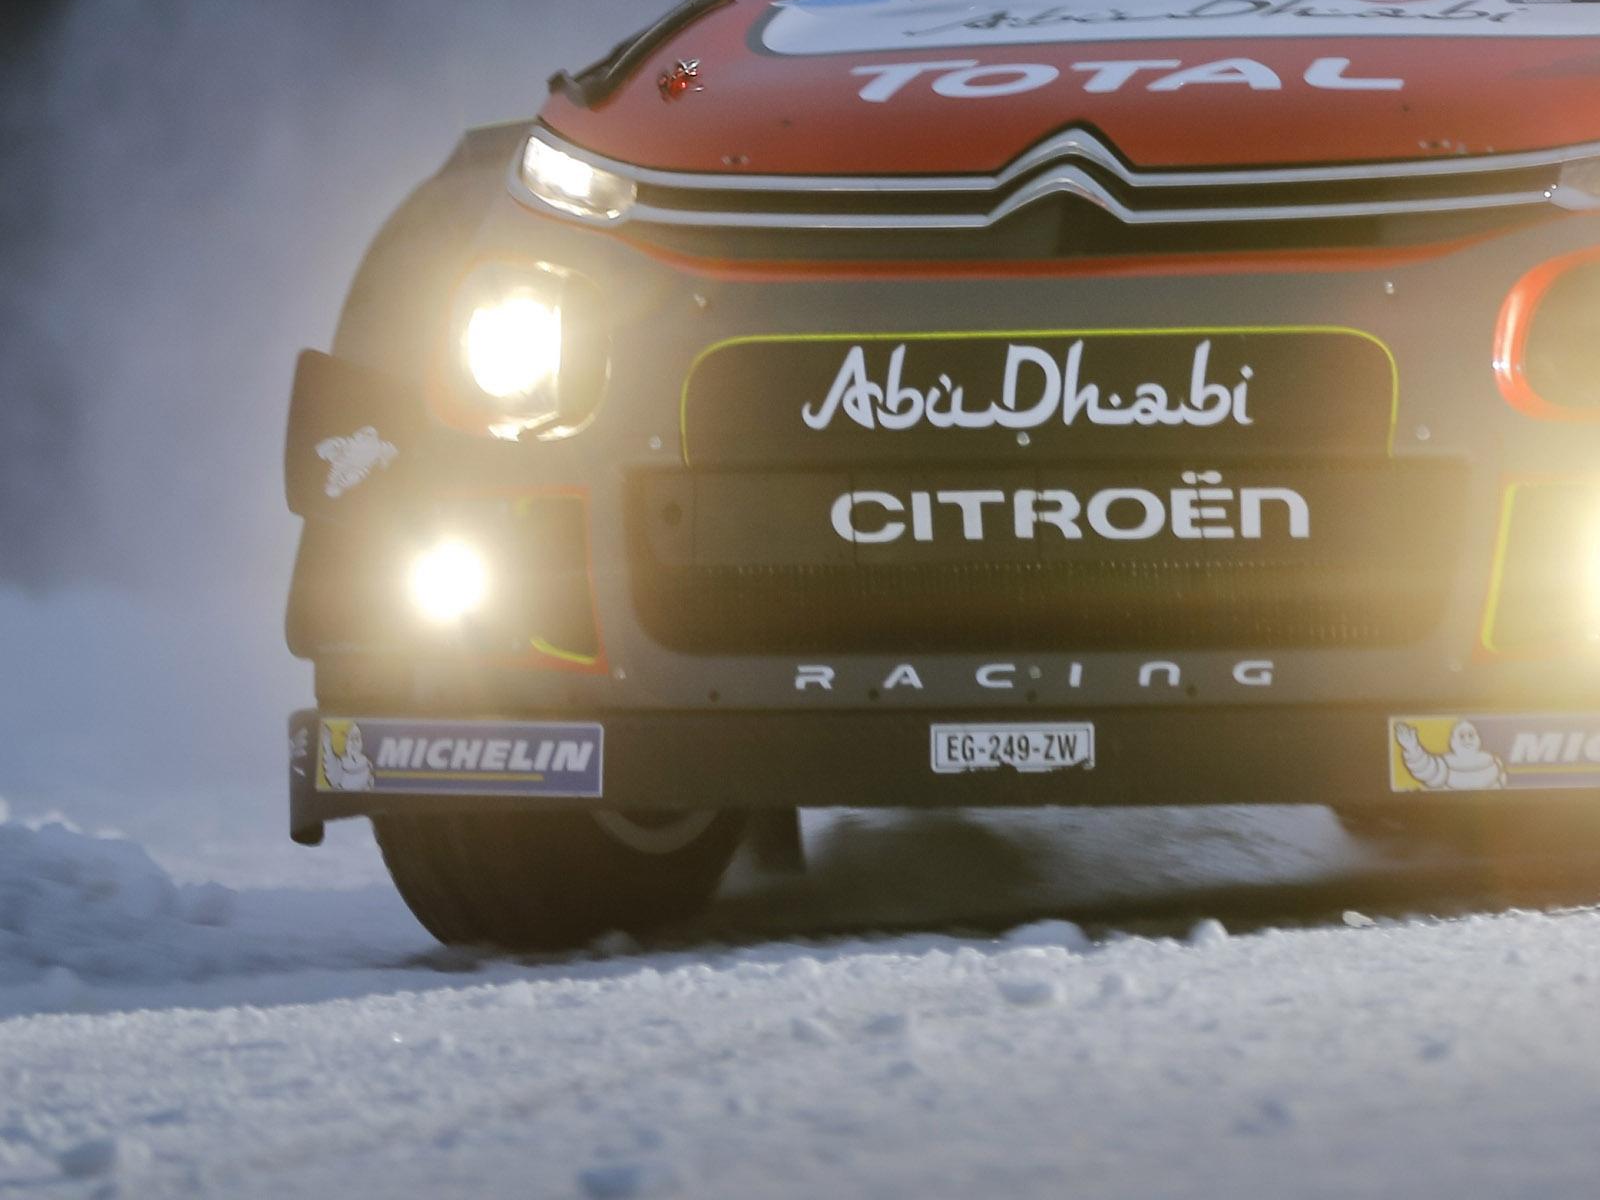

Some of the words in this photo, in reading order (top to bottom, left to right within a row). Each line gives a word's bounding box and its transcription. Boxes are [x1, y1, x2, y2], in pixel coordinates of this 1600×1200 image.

[850, 57, 1405, 102] TOTAL
[831, 470, 1310, 543] CITROËN
[376, 736, 595, 773] MICHELIN
[946, 734, 1078, 761] EG-249-ZW
